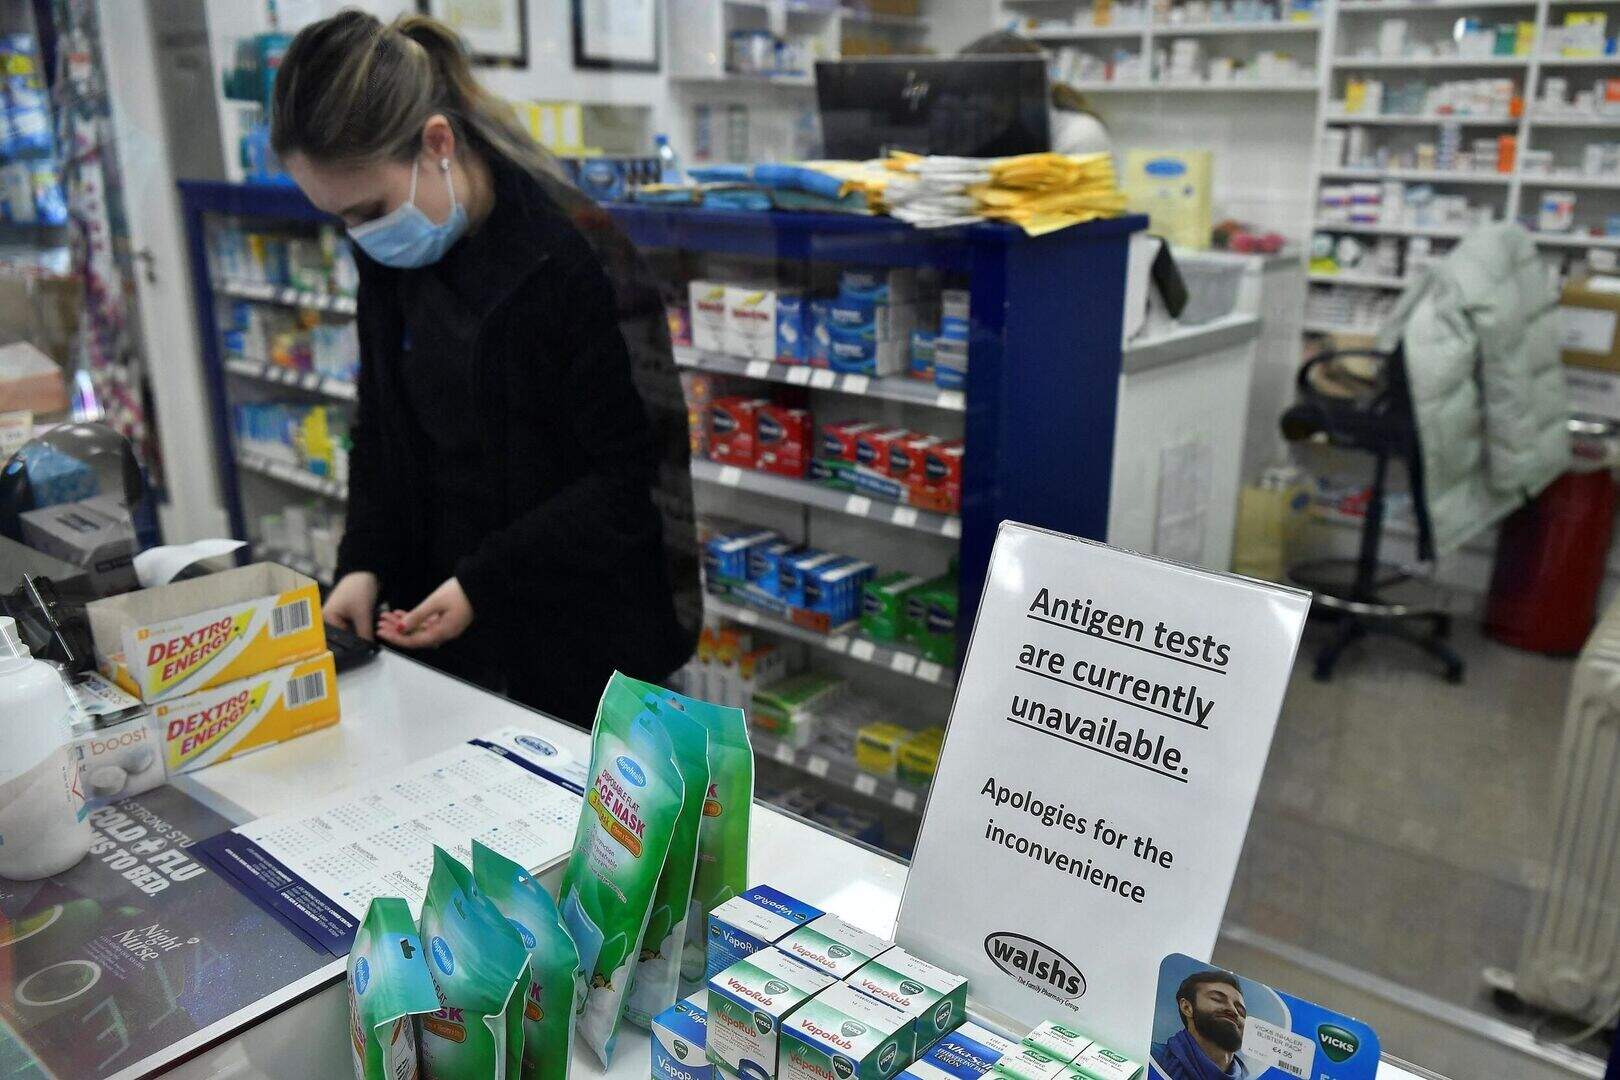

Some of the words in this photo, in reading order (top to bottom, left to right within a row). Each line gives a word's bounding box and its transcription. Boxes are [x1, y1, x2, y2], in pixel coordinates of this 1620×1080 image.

[147, 617, 233, 666] DEXTRO
[1029, 587, 1144, 641] Antigen
[1155, 619, 1232, 667] tests
[161, 628, 232, 682] ENERGY
[1019, 640, 1066, 674] are
[1072, 656, 1214, 727] currently
[166, 690, 249, 741] DEXTRO
[181, 704, 248, 756] ENERGY
[90, 726, 146, 755] boost
[1011, 695, 1189, 775] unavailable.
[125, 802, 172, 833] STRONG
[612, 799, 646, 839] MASK
[626, 794, 640, 812] FLAT
[981, 777, 1087, 835] Apologies
[1093, 819, 1128, 849] for
[1133, 837, 1175, 870] the
[90, 805, 148, 842] COLD
[147, 849, 207, 881] FLU
[102, 848, 138, 870] TO
[122, 865, 170, 897] BED.
[985, 819, 1146, 903] inconvenience
[753, 894, 792, 916] VapoRub
[112, 929, 159, 961] Nurse
[140, 924, 184, 951] Night
[792, 942, 837, 970] VapoRub
[994, 938, 1080, 995] walshs
[727, 977, 774, 1007] VapoRub
[862, 978, 911, 1007] VapoRub
[1025, 980, 1041, 993] Family
[1041, 988, 1064, 1005] Pharmacy
[1065, 1000, 1079, 1012] Group
[715, 1009, 757, 1038] VapoRub
[800, 1019, 853, 1051] VapoRub
[1320, 1033, 1355, 1053] VICKS
[934, 1053, 961, 1068] LEMON
